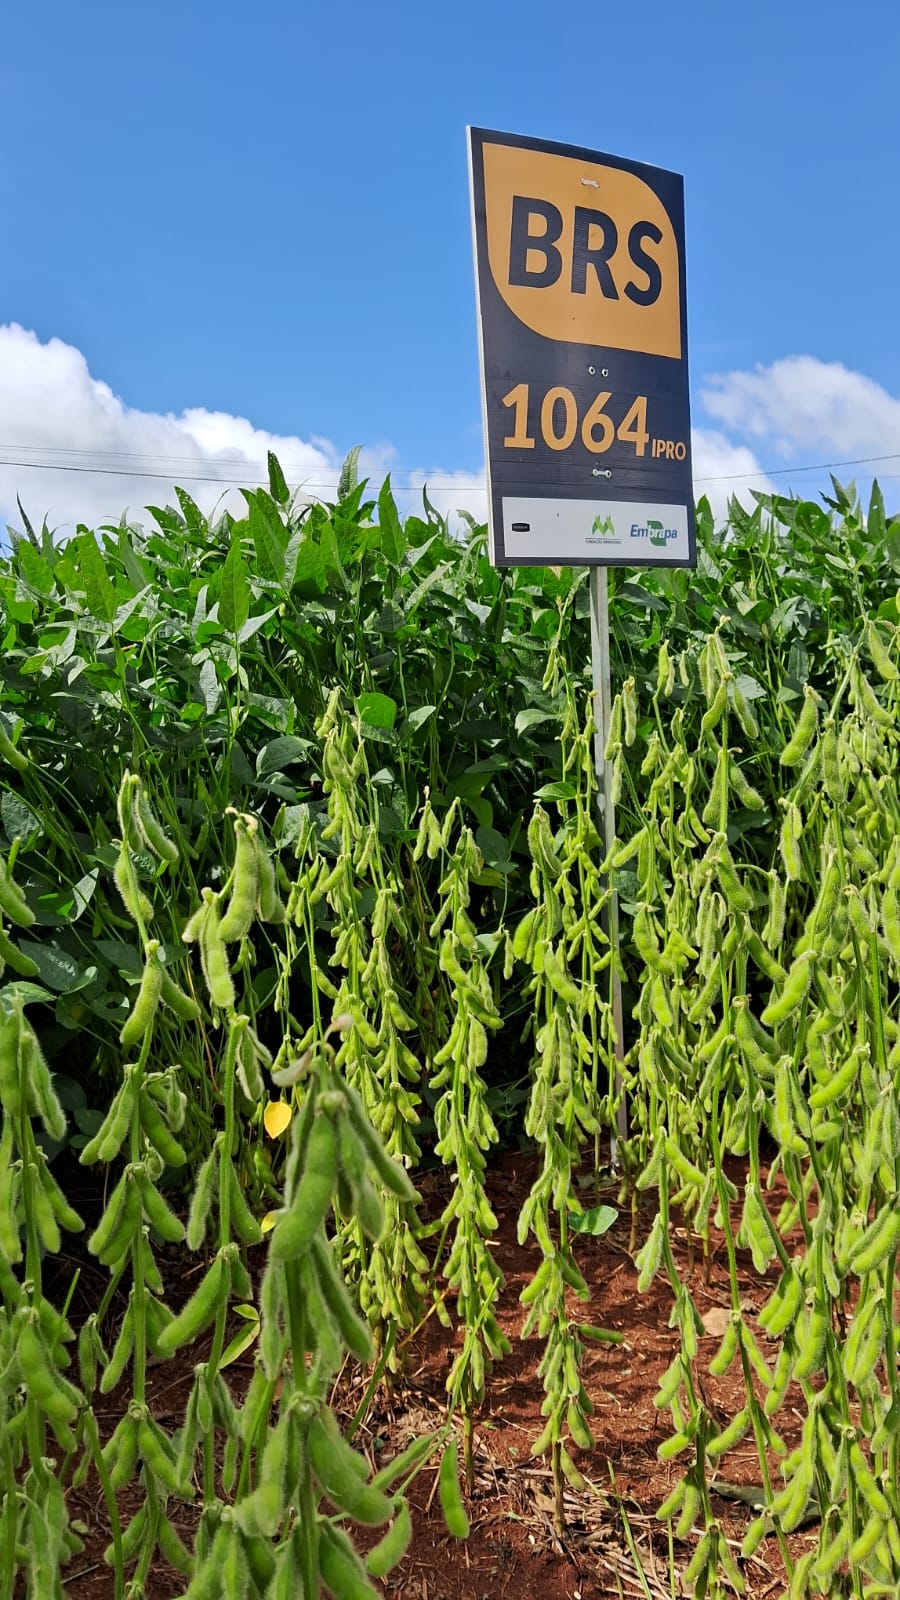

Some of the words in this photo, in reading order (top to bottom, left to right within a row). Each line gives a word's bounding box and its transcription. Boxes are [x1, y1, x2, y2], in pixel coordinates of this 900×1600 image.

[508, 195, 663, 306] BRS
[502, 384, 650, 457] 1064
[652, 438, 686, 461] IPRO
[630, 523, 678, 539] Embrapa
